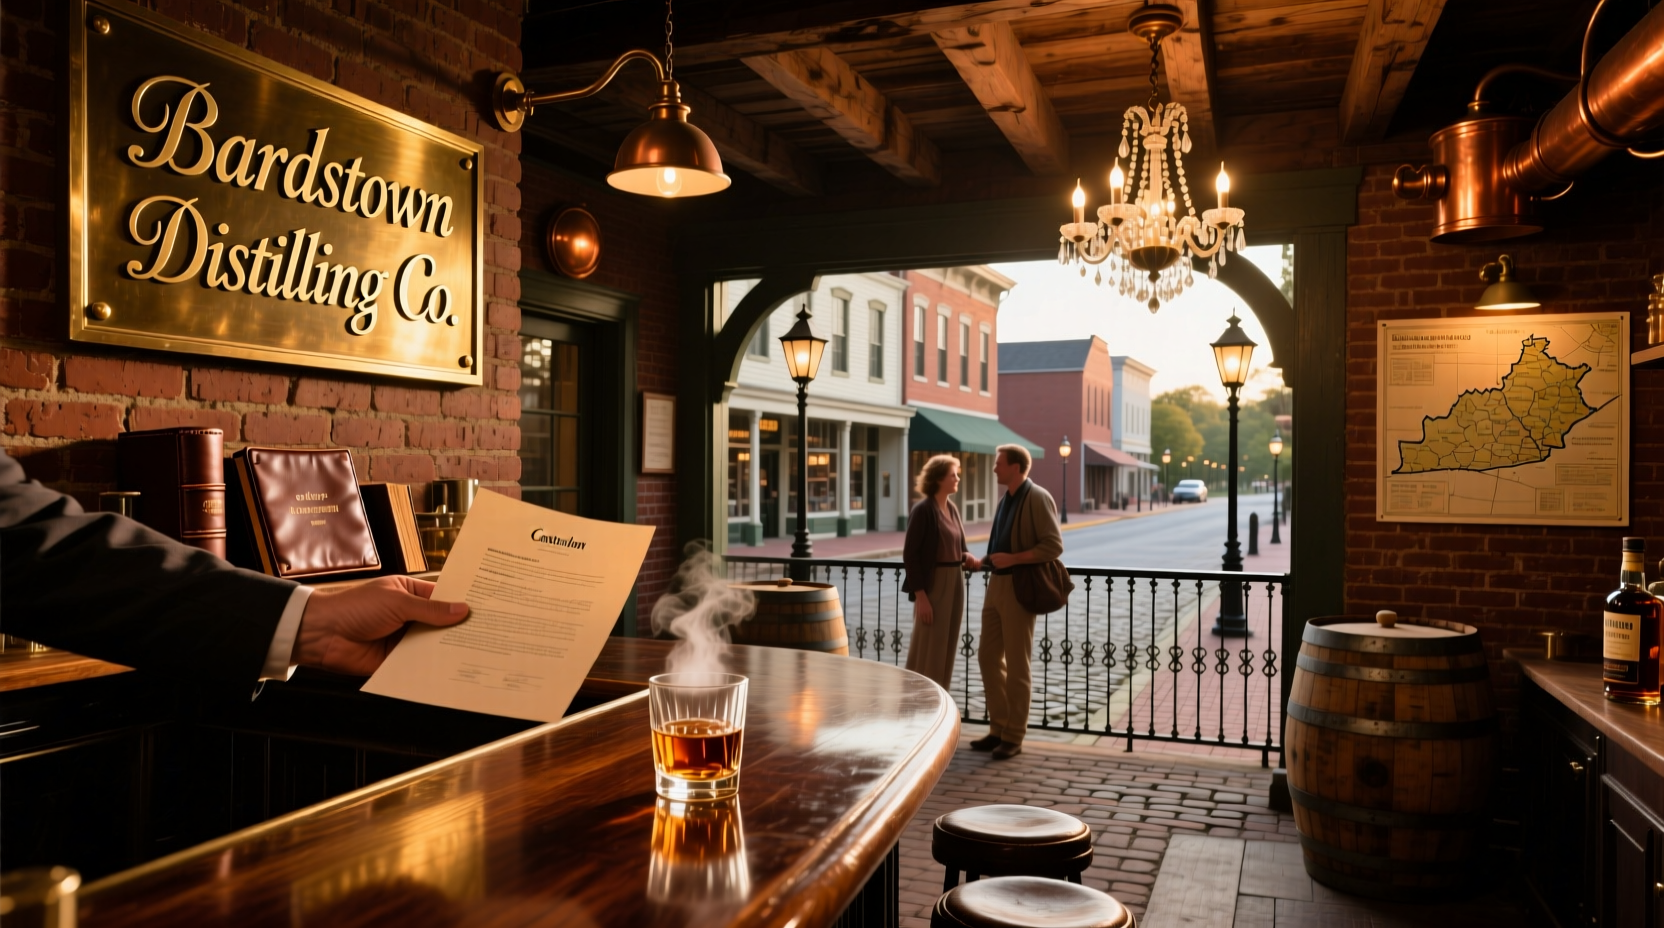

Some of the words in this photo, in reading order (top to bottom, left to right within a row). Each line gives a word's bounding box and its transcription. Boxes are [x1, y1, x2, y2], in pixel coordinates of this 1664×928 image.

[127, 75, 453, 237] Bardstown
[126, 195, 389, 335] Distilling
[399, 254, 459, 326] Co.
